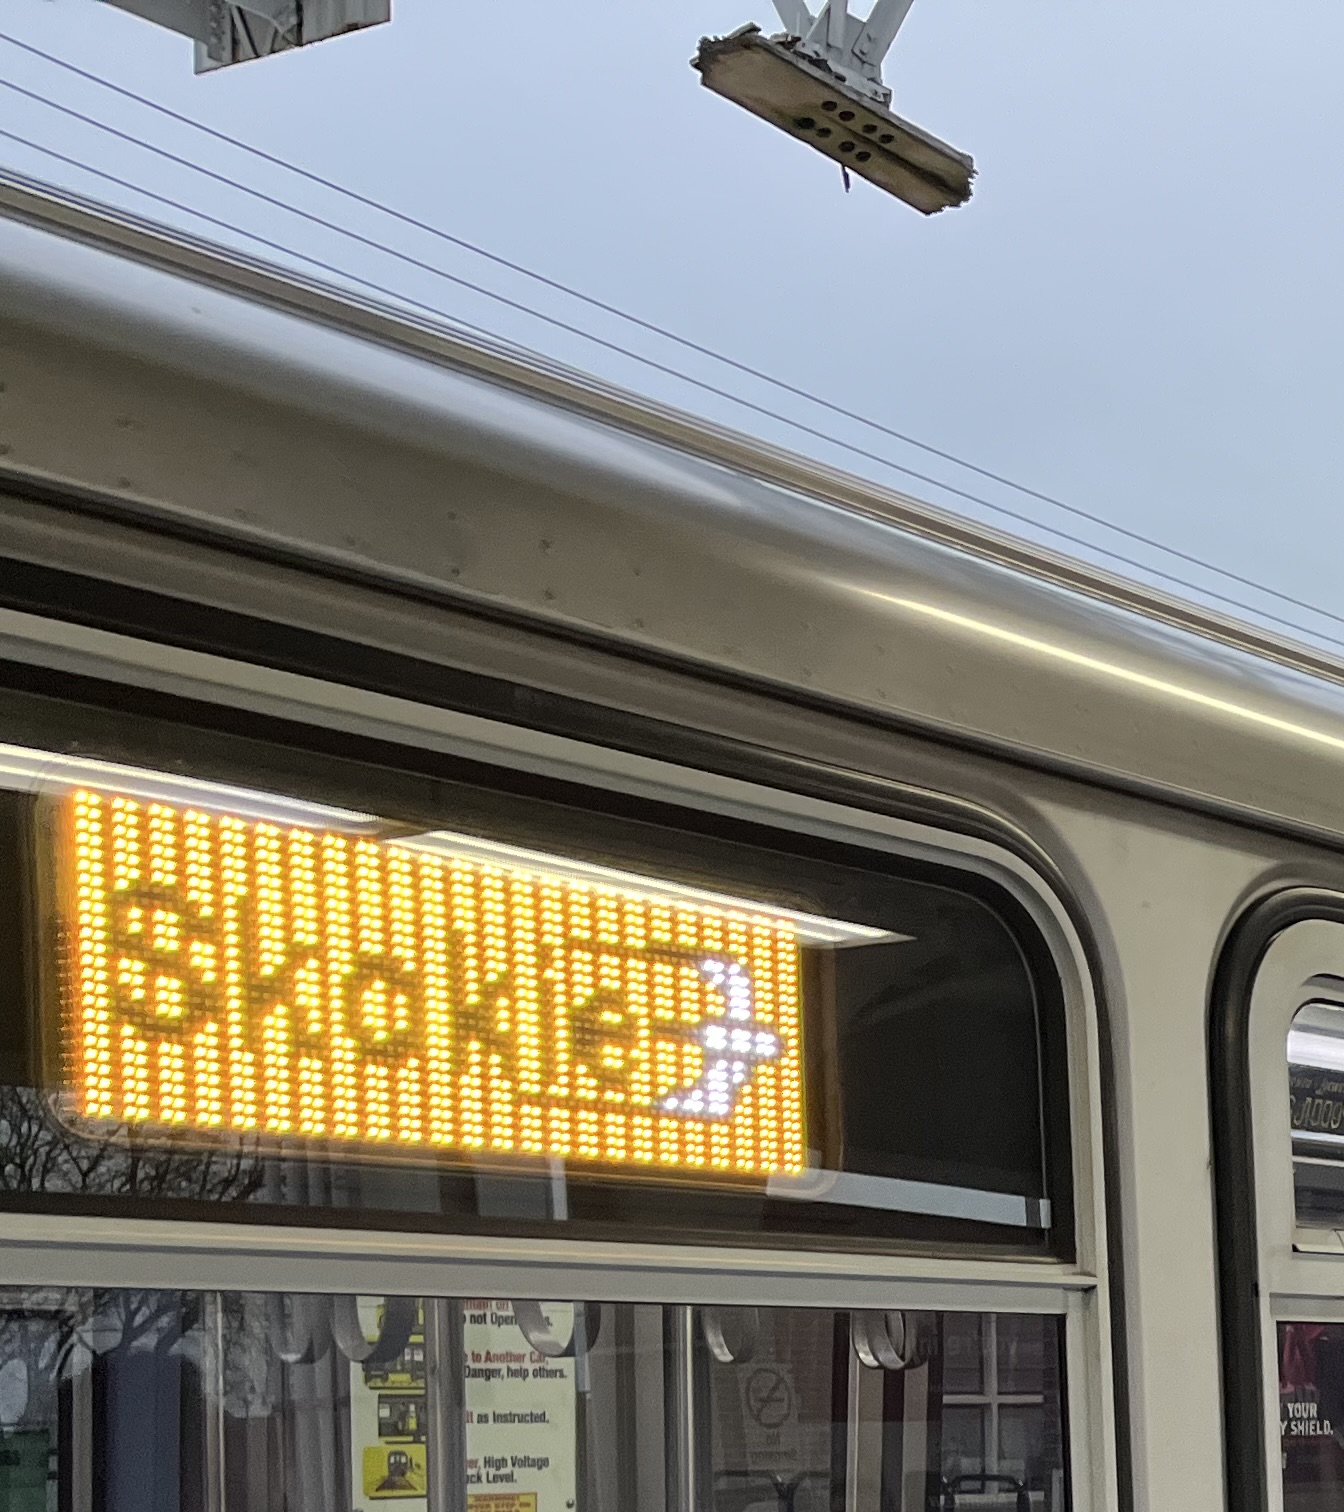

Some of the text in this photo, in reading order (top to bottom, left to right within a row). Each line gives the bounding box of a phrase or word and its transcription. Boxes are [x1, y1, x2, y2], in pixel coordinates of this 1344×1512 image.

[105, 880, 640, 1090] Skokie
[470, 1312, 487, 1324] not
[471, 1351, 482, 1363] to
[484, 1351, 526, 1363] Another
[507, 1366, 528, 1381] help
[532, 1367, 567, 1379] others.
[477, 1413, 489, 1424] as
[493, 1410, 549, 1424] Instructed.
[1287, 1403, 1317, 1418] YOUR
[1291, 1420, 1333, 1435] SHIELD.
[484, 1456, 507, 1471] High
[511, 1455, 549, 1471] Voltage
[487, 1470, 517, 1483] Level.
